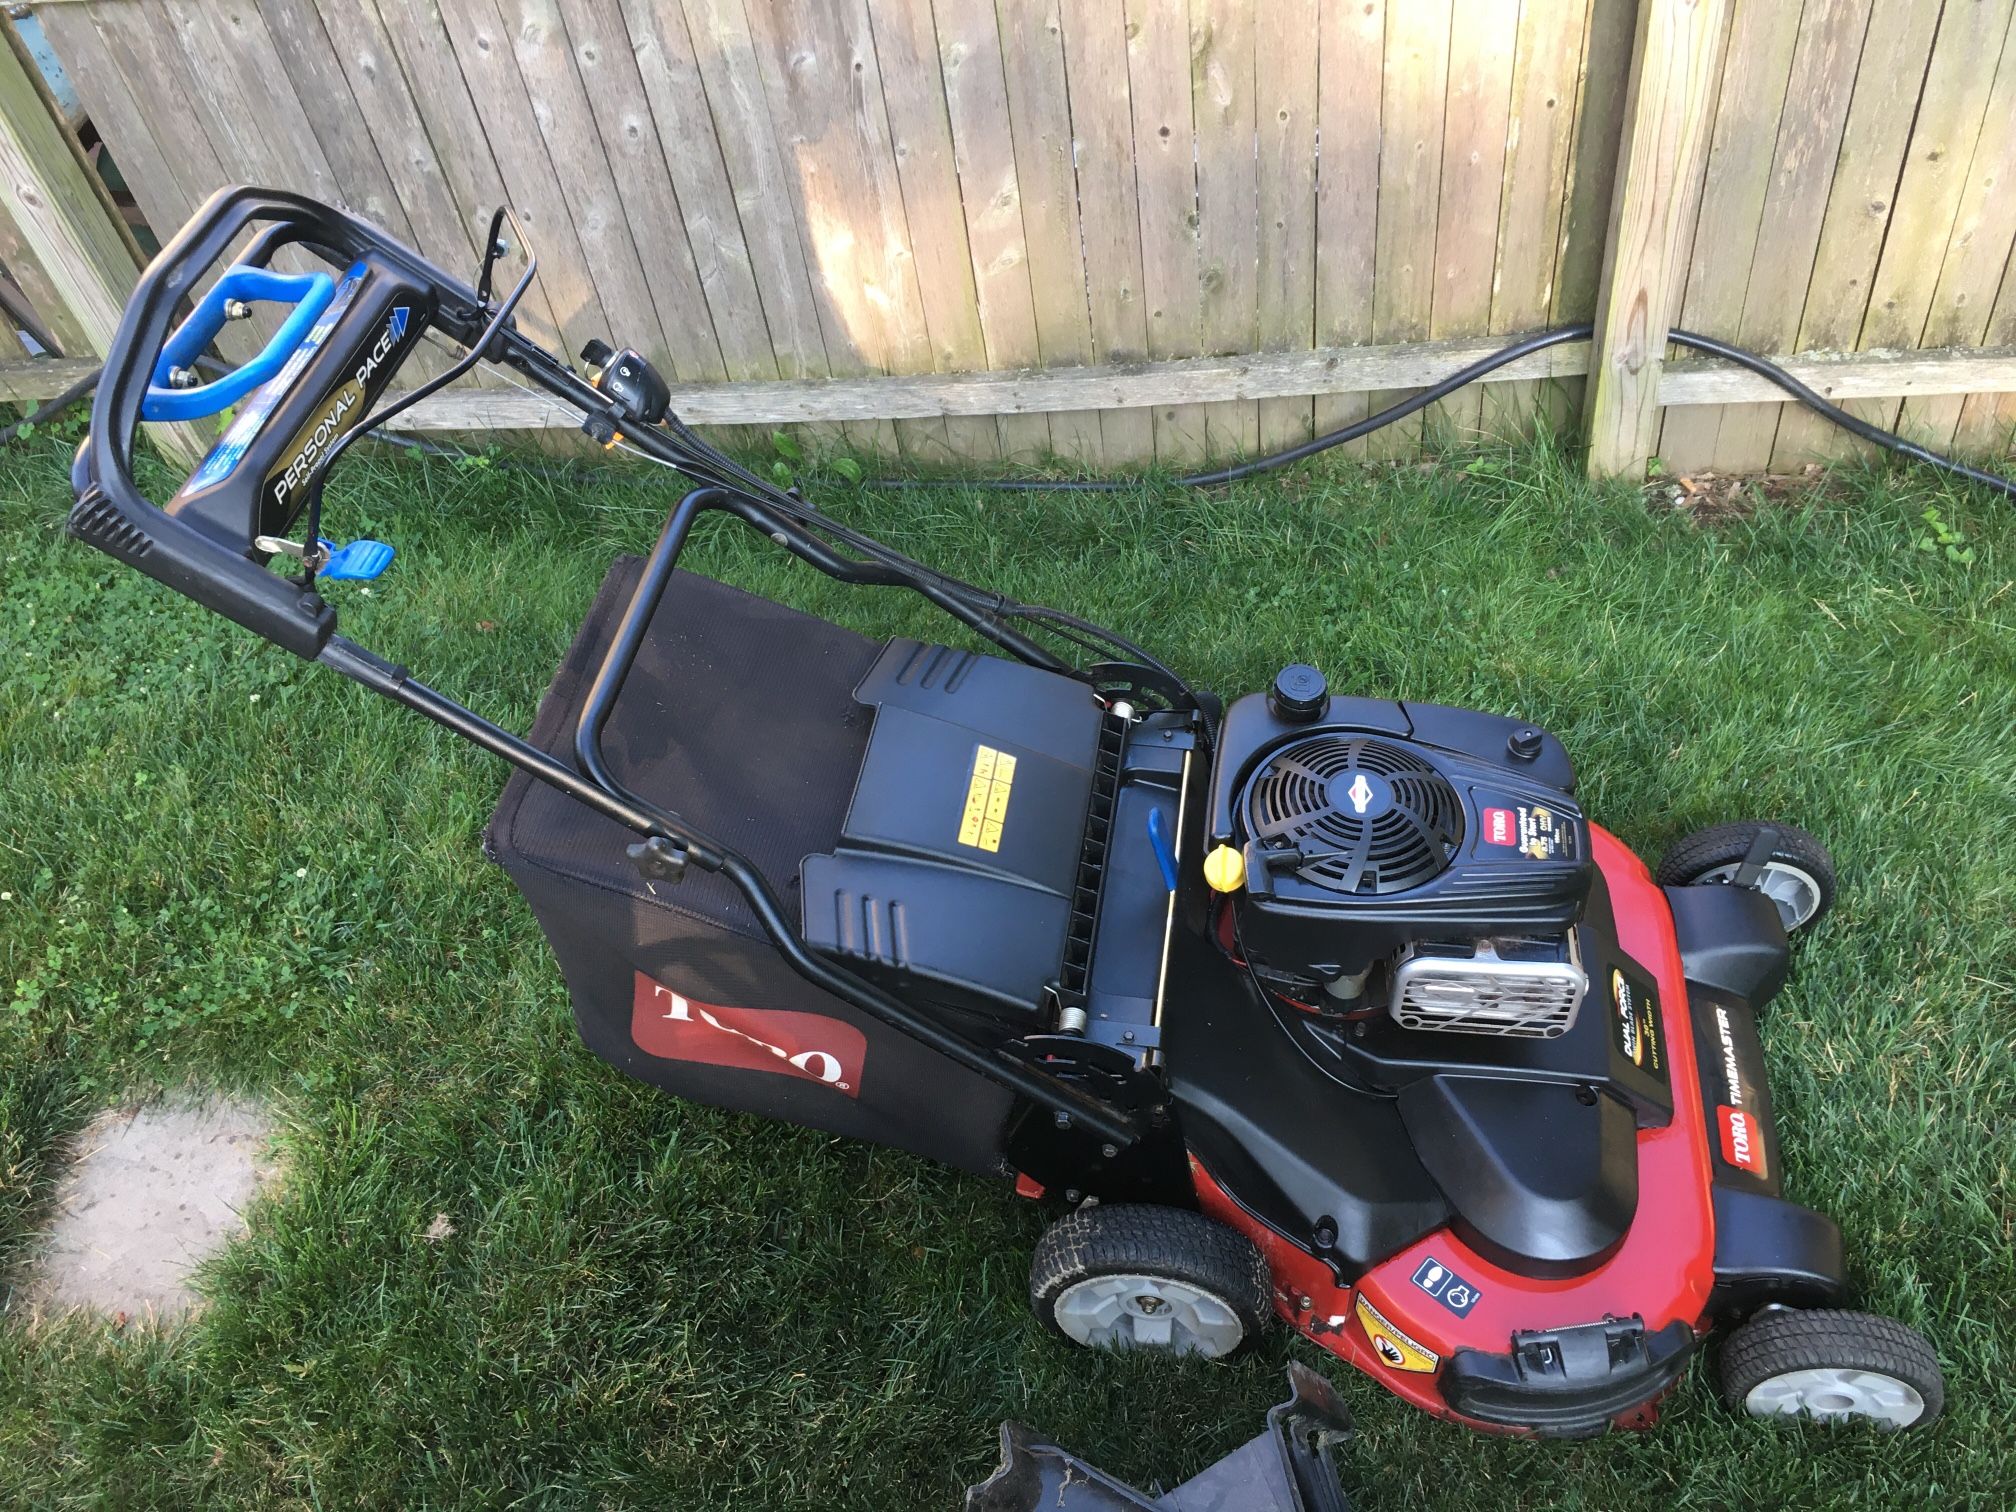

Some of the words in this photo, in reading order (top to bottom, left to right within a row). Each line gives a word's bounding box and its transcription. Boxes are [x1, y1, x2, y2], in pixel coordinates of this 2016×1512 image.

[274, 391, 356, 505] PERSONAL
[355, 330, 393, 389] PACE
[1492, 810, 1507, 842] TORO
[1616, 975, 1629, 1020] FORCE
[1624, 984, 1633, 1011] SYSTEM
[1645, 998, 1655, 1029] WIDTH
[1622, 1022, 1633, 1058] DUAL
[1627, 1011, 1636, 1035] BLADE
[1649, 1028, 1660, 1070] CUTTING
[1716, 1007, 1743, 1106] TIMEMASTER
[1729, 1112, 1751, 1164] TORO
